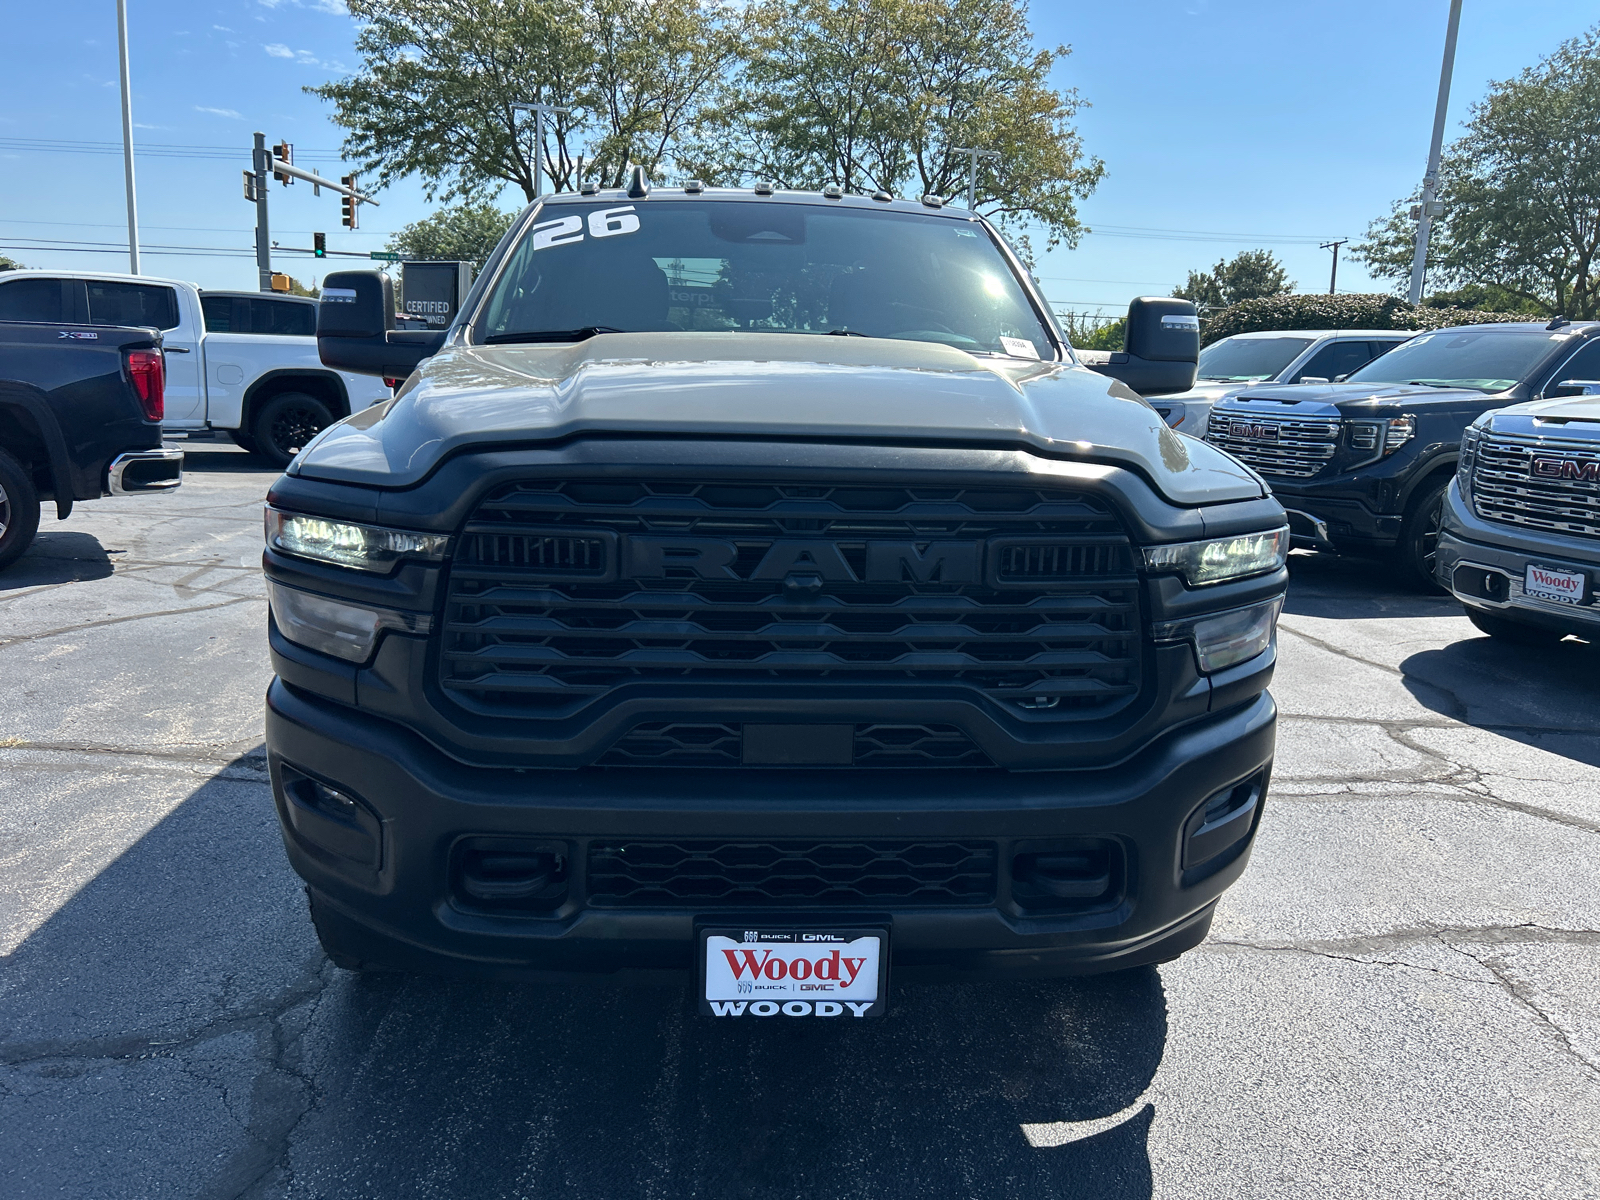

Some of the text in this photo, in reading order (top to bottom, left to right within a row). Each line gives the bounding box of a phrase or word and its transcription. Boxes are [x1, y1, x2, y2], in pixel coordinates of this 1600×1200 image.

[532, 205, 640, 251] 26
[406, 300, 449, 313] CERTIFIED
[1230, 422, 1277, 439] GMC
[1534, 457, 1600, 481] GM
[624, 535, 981, 584] RAM
[1532, 569, 1580, 593] Woody
[1526, 589, 1580, 605] WOODY
[802, 933, 845, 942] GMC
[721, 949, 867, 988] Woody
[800, 983, 834, 991] GMC
[709, 1001, 874, 1018] WOODY
